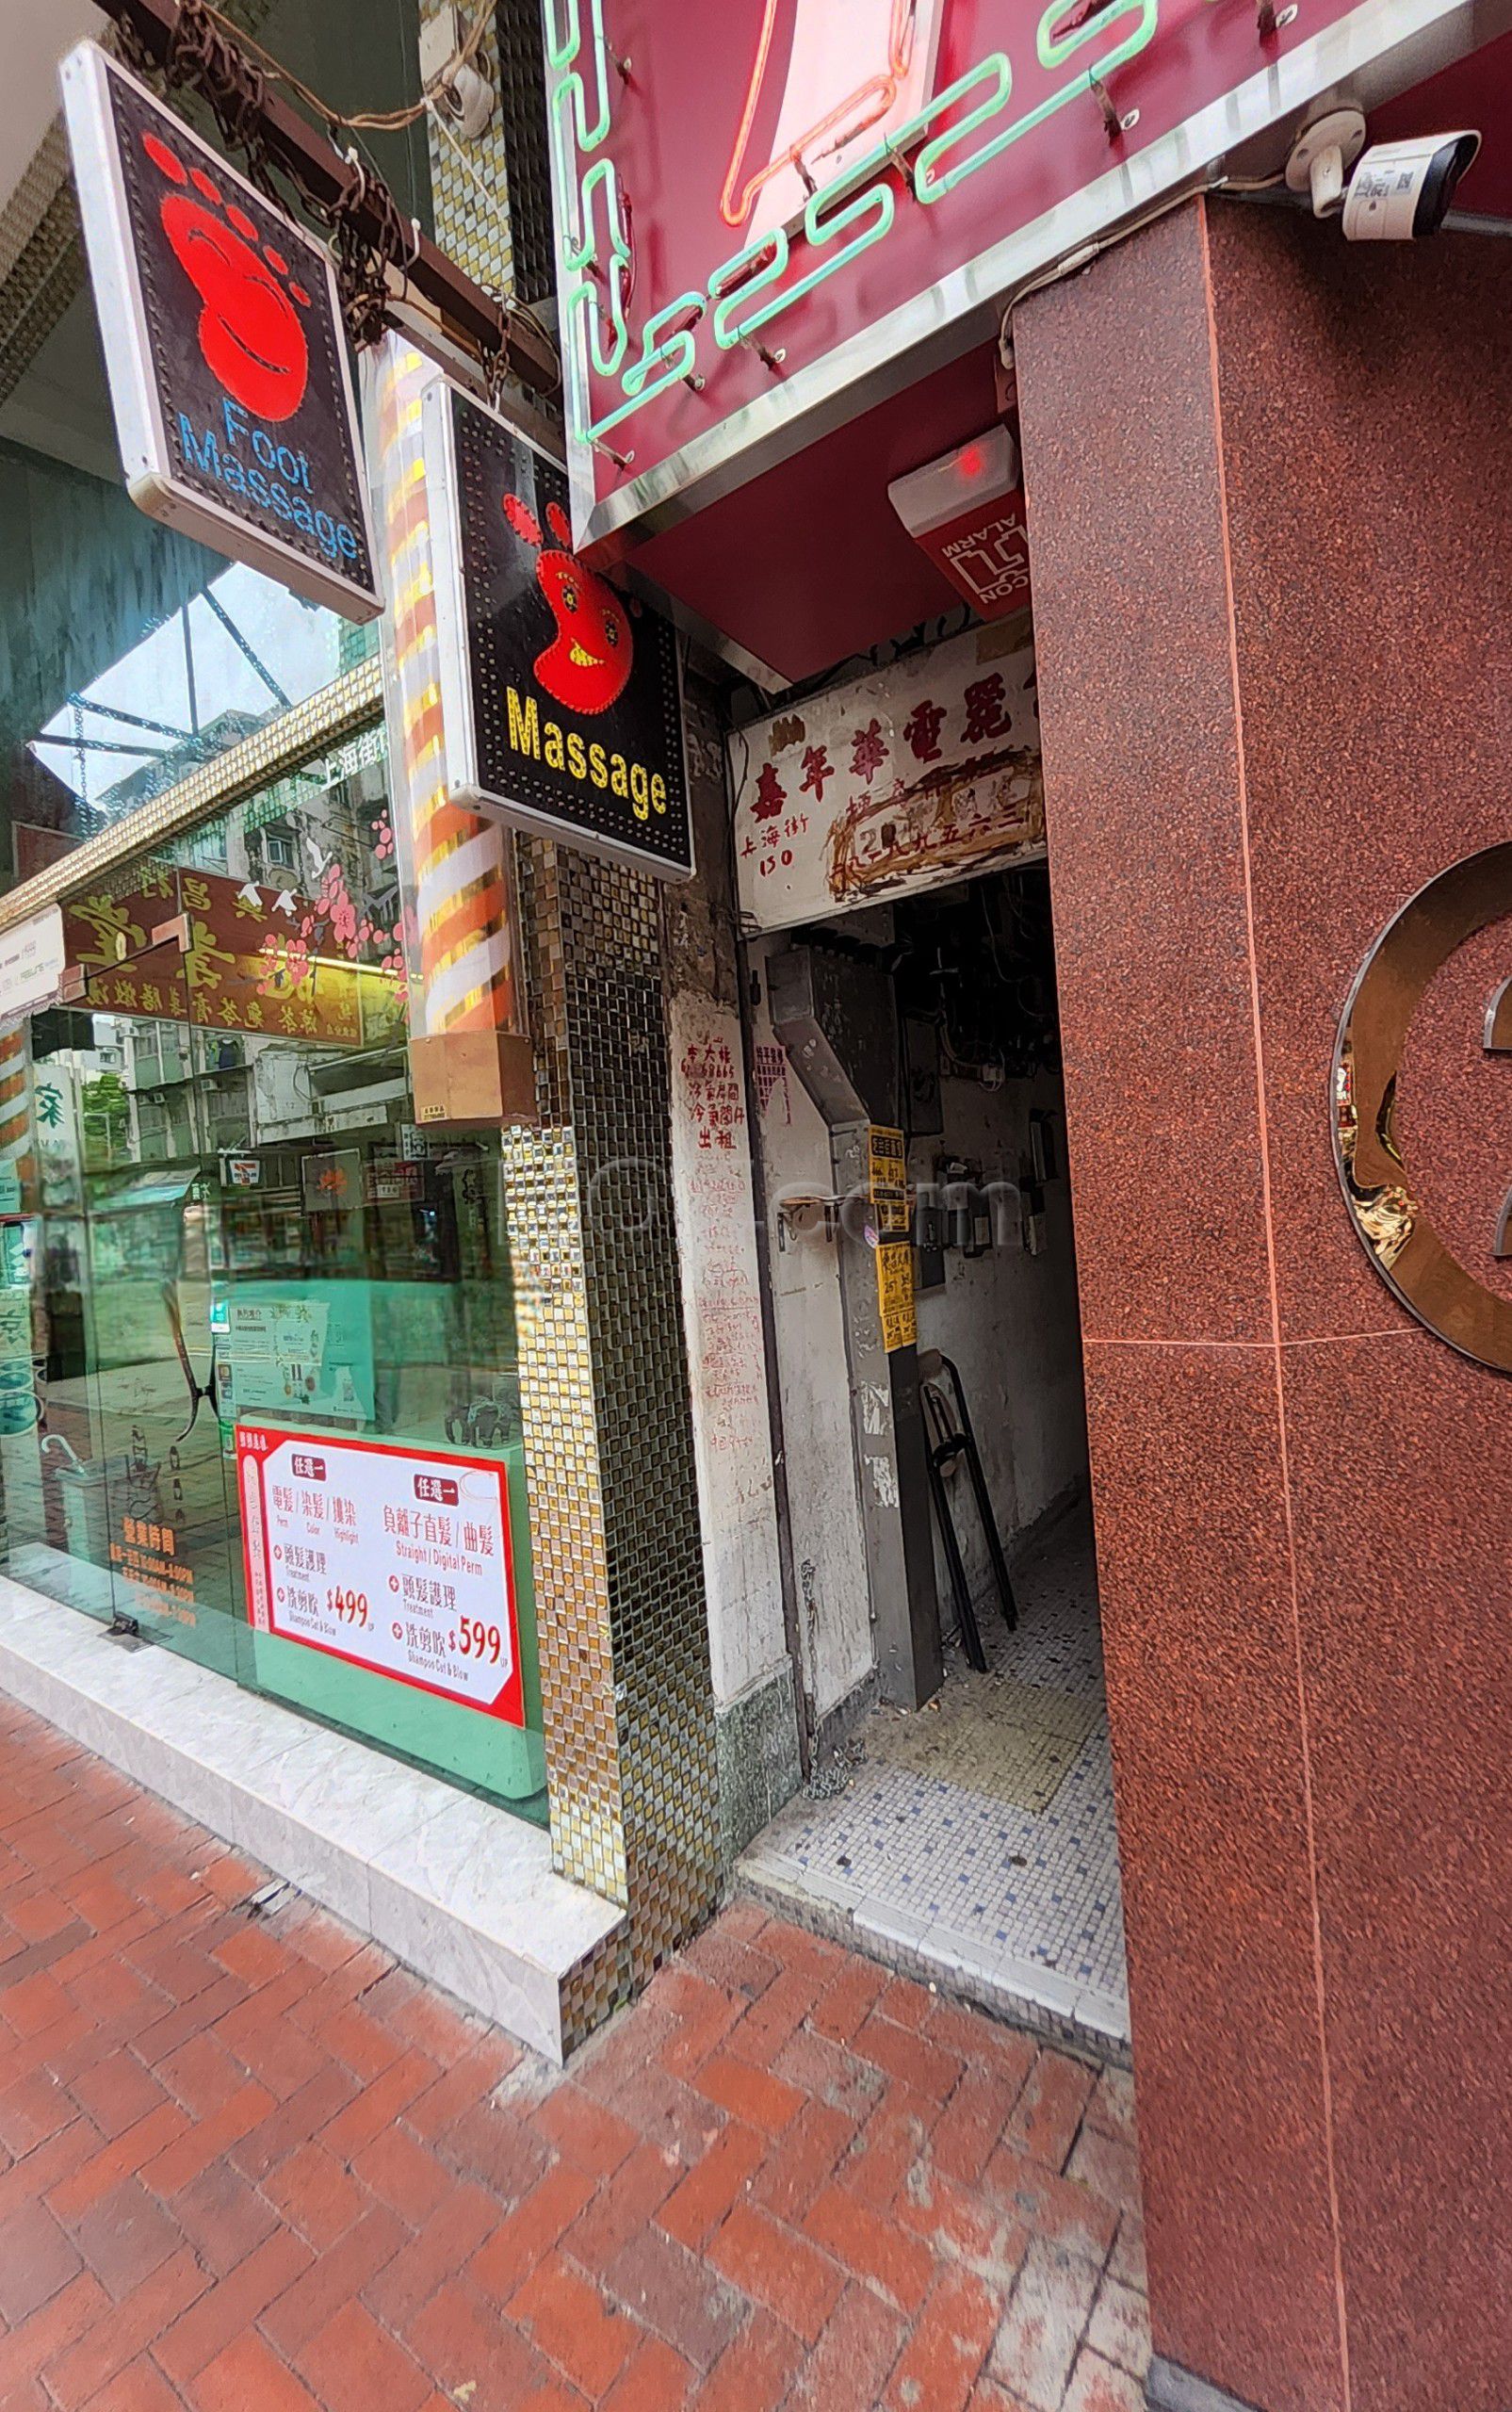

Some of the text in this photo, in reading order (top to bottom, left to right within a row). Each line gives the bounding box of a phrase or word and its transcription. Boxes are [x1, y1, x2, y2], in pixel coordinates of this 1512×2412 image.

[222, 397, 314, 494] Foot
[178, 411, 358, 560] Massage
[941, 512, 1016, 559] ALARM
[506, 686, 667, 821] Massage
[740, 813, 808, 858] 上海街
[759, 849, 793, 877] 150
[698, 1126, 738, 1150] 出租
[294, 1457, 324, 1478] 任選一
[417, 1477, 456, 1503] 任選一
[383, 1504, 452, 1548] 負離子直髮
[463, 1521, 495, 1557] 曲髮
[396, 1540, 428, 1564] Straight
[433, 1548, 461, 1571] Digital
[461, 1556, 483, 1576] Perm
[326, 1585, 368, 1628] $499
[401, 1573, 458, 1612] 頭髮護理
[405, 1622, 447, 1659] 洗剪吹
[448, 1614, 502, 1665] $599
